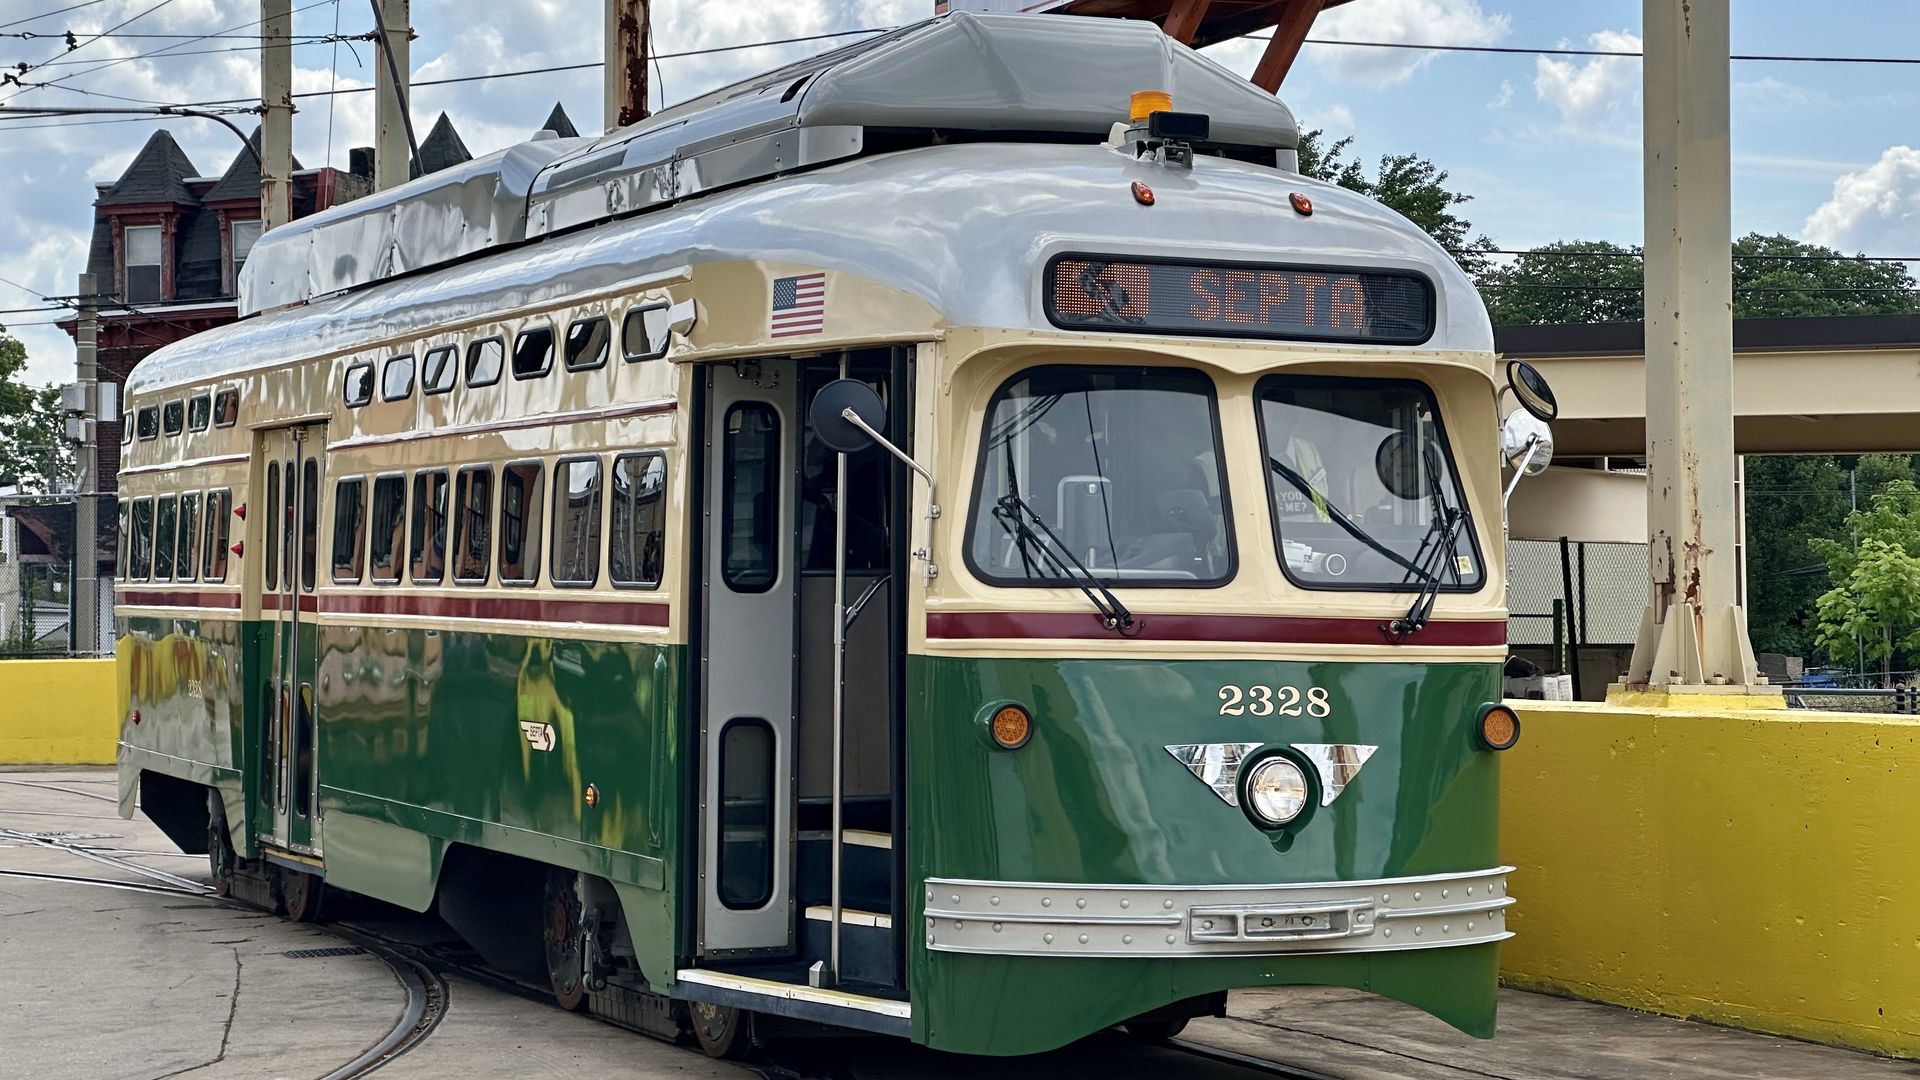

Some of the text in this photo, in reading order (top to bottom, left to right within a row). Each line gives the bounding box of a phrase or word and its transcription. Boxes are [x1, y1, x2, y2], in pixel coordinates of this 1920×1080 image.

[1190, 269, 1363, 329] SEPTA
[1280, 491, 1303, 501] YOU
[1285, 502, 1307, 513] ME?
[1217, 684, 1332, 718] 2328
